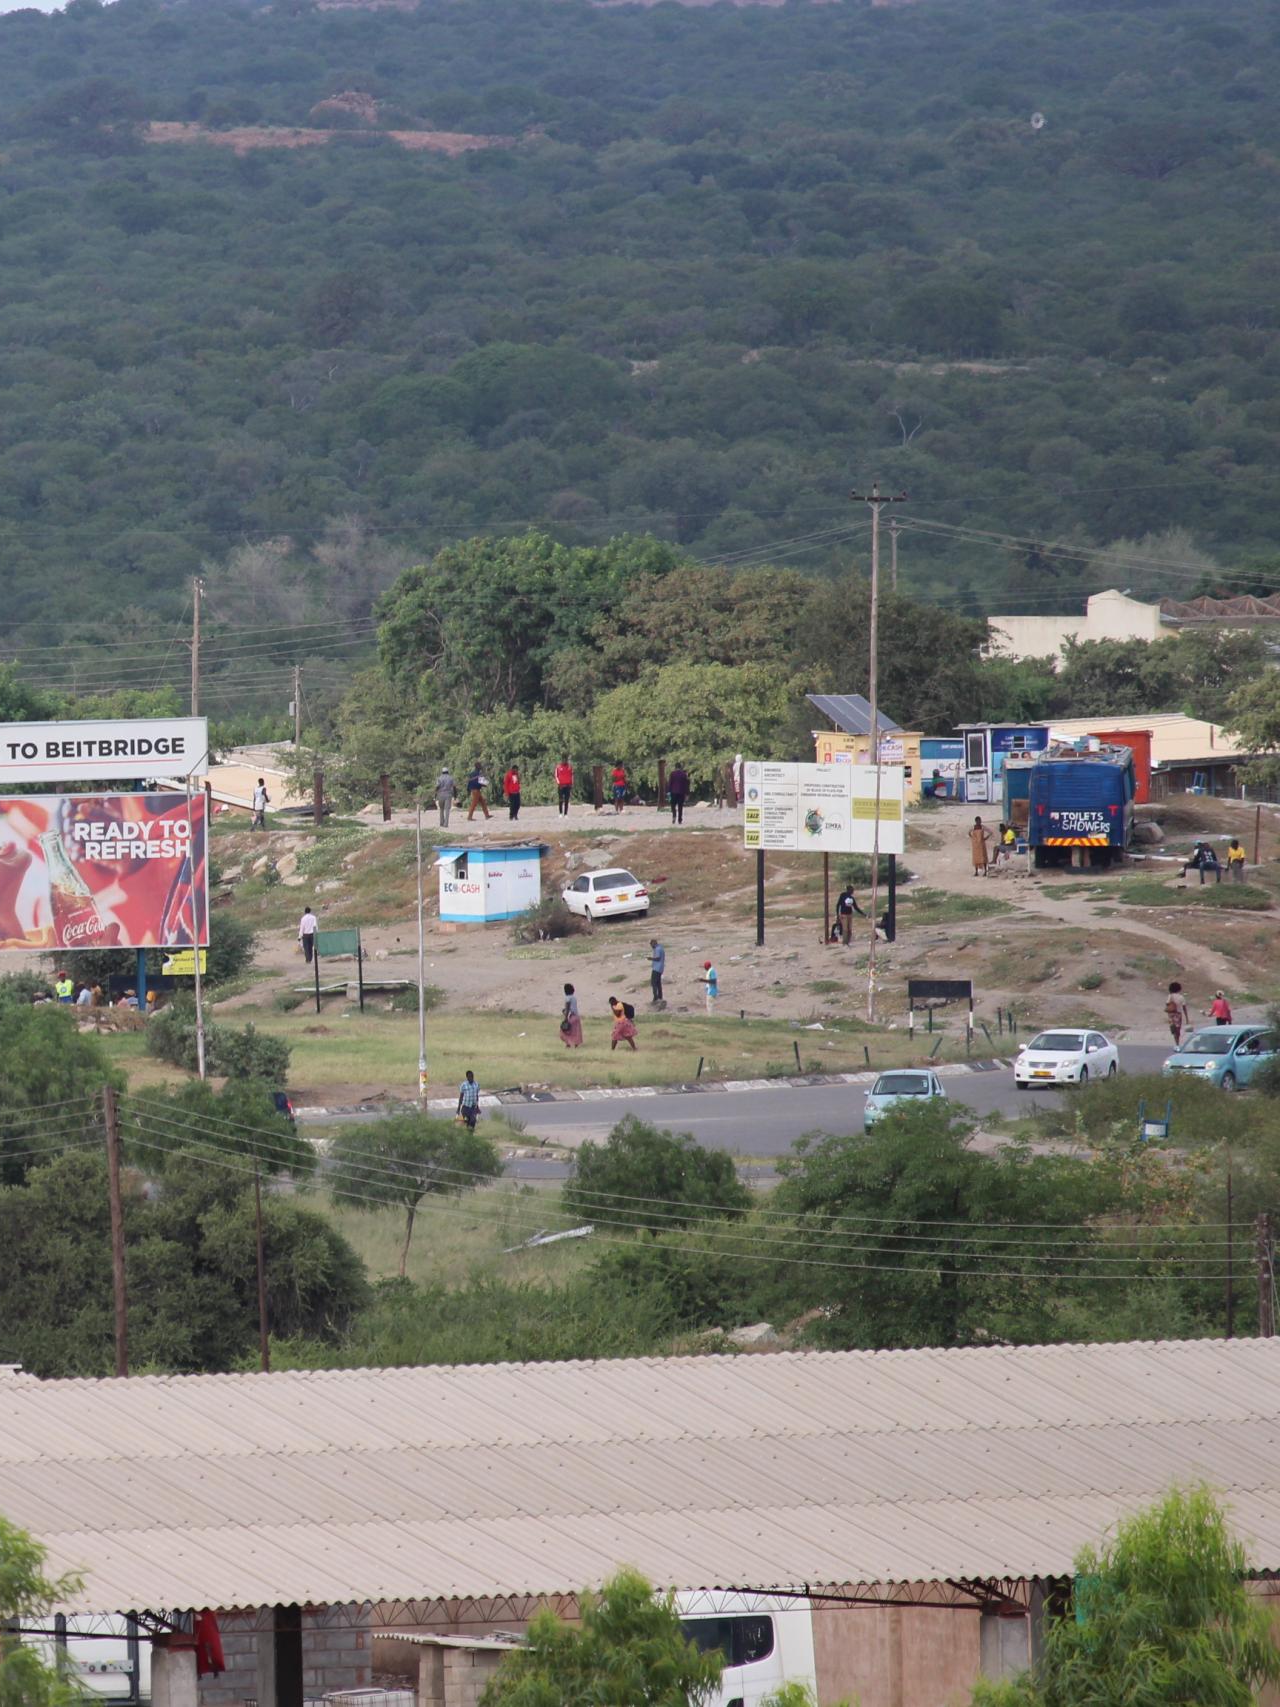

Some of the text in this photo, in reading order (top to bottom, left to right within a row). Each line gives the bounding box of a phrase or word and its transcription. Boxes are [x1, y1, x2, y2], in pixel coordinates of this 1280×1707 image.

[7, 742, 39, 760] TO
[45, 737, 186, 758] BEITBRIDGE
[1061, 812, 1104, 821] TOILETS
[1062, 819, 1111, 833] SHOWERS
[74, 819, 191, 841] READY TO
[85, 839, 191, 860] REFRESH
